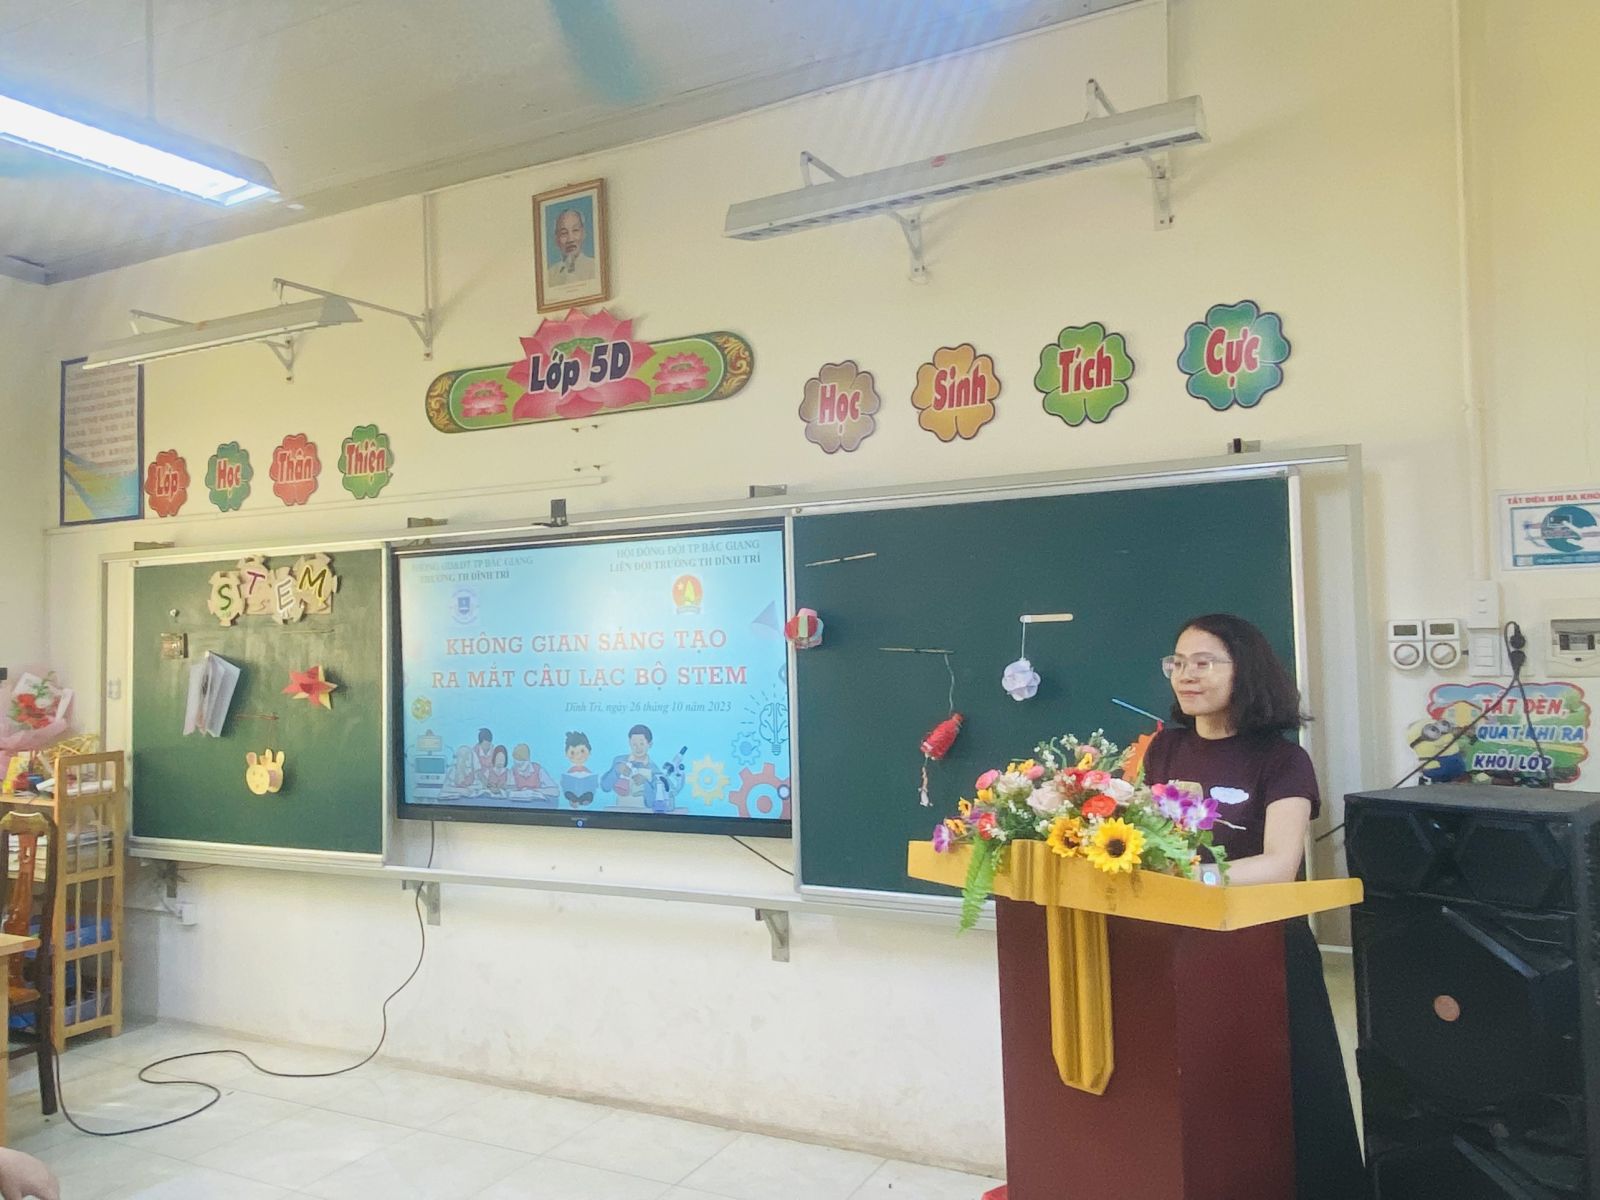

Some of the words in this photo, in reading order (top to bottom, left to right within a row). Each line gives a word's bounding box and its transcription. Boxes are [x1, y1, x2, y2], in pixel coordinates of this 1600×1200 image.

[529, 349, 580, 396] Lớp
[589, 340, 632, 384] 5D
[818, 383, 860, 435] Học
[932, 362, 986, 411] Sinh
[1057, 345, 1113, 394] Tích
[1205, 327, 1261, 389] Cực
[156, 463, 179, 502] Lớp
[216, 458, 242, 497] Học
[278, 449, 313, 483] Thân
[346, 440, 386, 484] Thiện
[687, 543, 700, 553] TP
[725, 539, 760, 551] GIANG
[697, 557, 714, 567] TH
[458, 573, 469, 581] TH
[446, 632, 523, 656] KHÔNG
[531, 634, 590, 654] GIAN
[599, 627, 665, 651] SÁNG
[674, 630, 727, 653] TẠO
[432, 670, 460, 688] RA
[467, 662, 515, 688] MẮT
[524, 663, 571, 688] CÂU
[578, 668, 625, 691] LẠC
[634, 661, 667, 691] BỘ
[677, 666, 747, 686] STEM
[630, 701, 641, 712] 26
[671, 701, 683, 711] 10
[707, 701, 732, 712] 2023
[1525, 725, 1556, 741] KHI
[1561, 726, 1585, 741] RA
